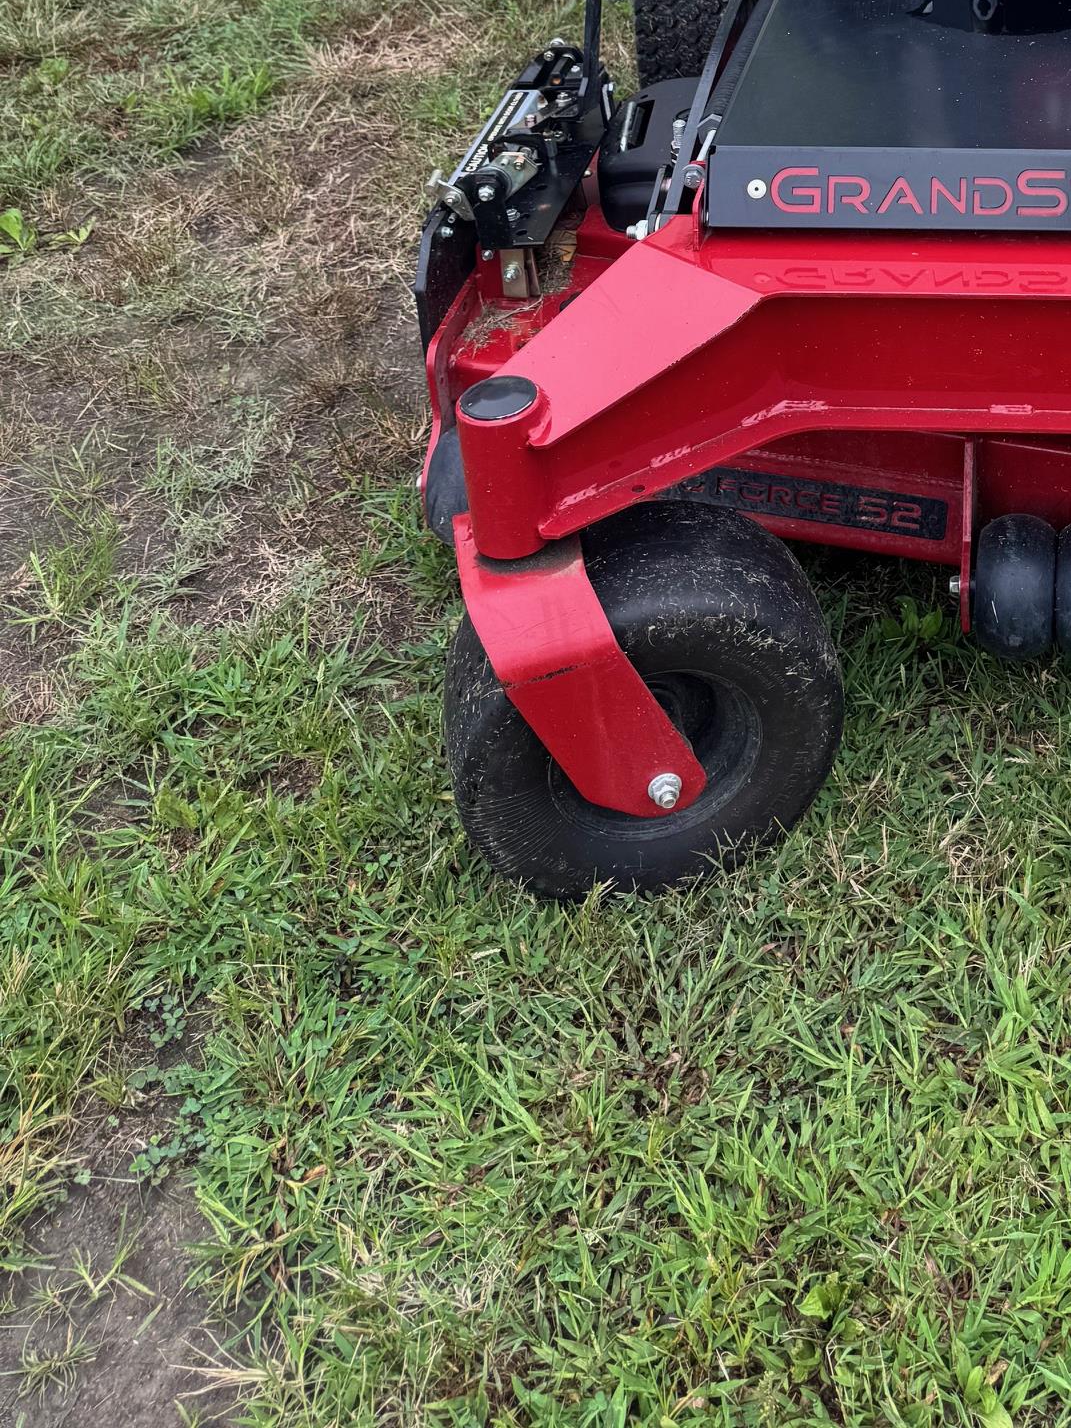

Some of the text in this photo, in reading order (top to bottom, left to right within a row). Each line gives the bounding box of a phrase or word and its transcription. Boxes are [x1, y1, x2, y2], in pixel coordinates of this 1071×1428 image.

[465, 144, 488, 172] CAUTION
[717, 476, 843, 514] FORCE
[859, 494, 923, 530] 52
